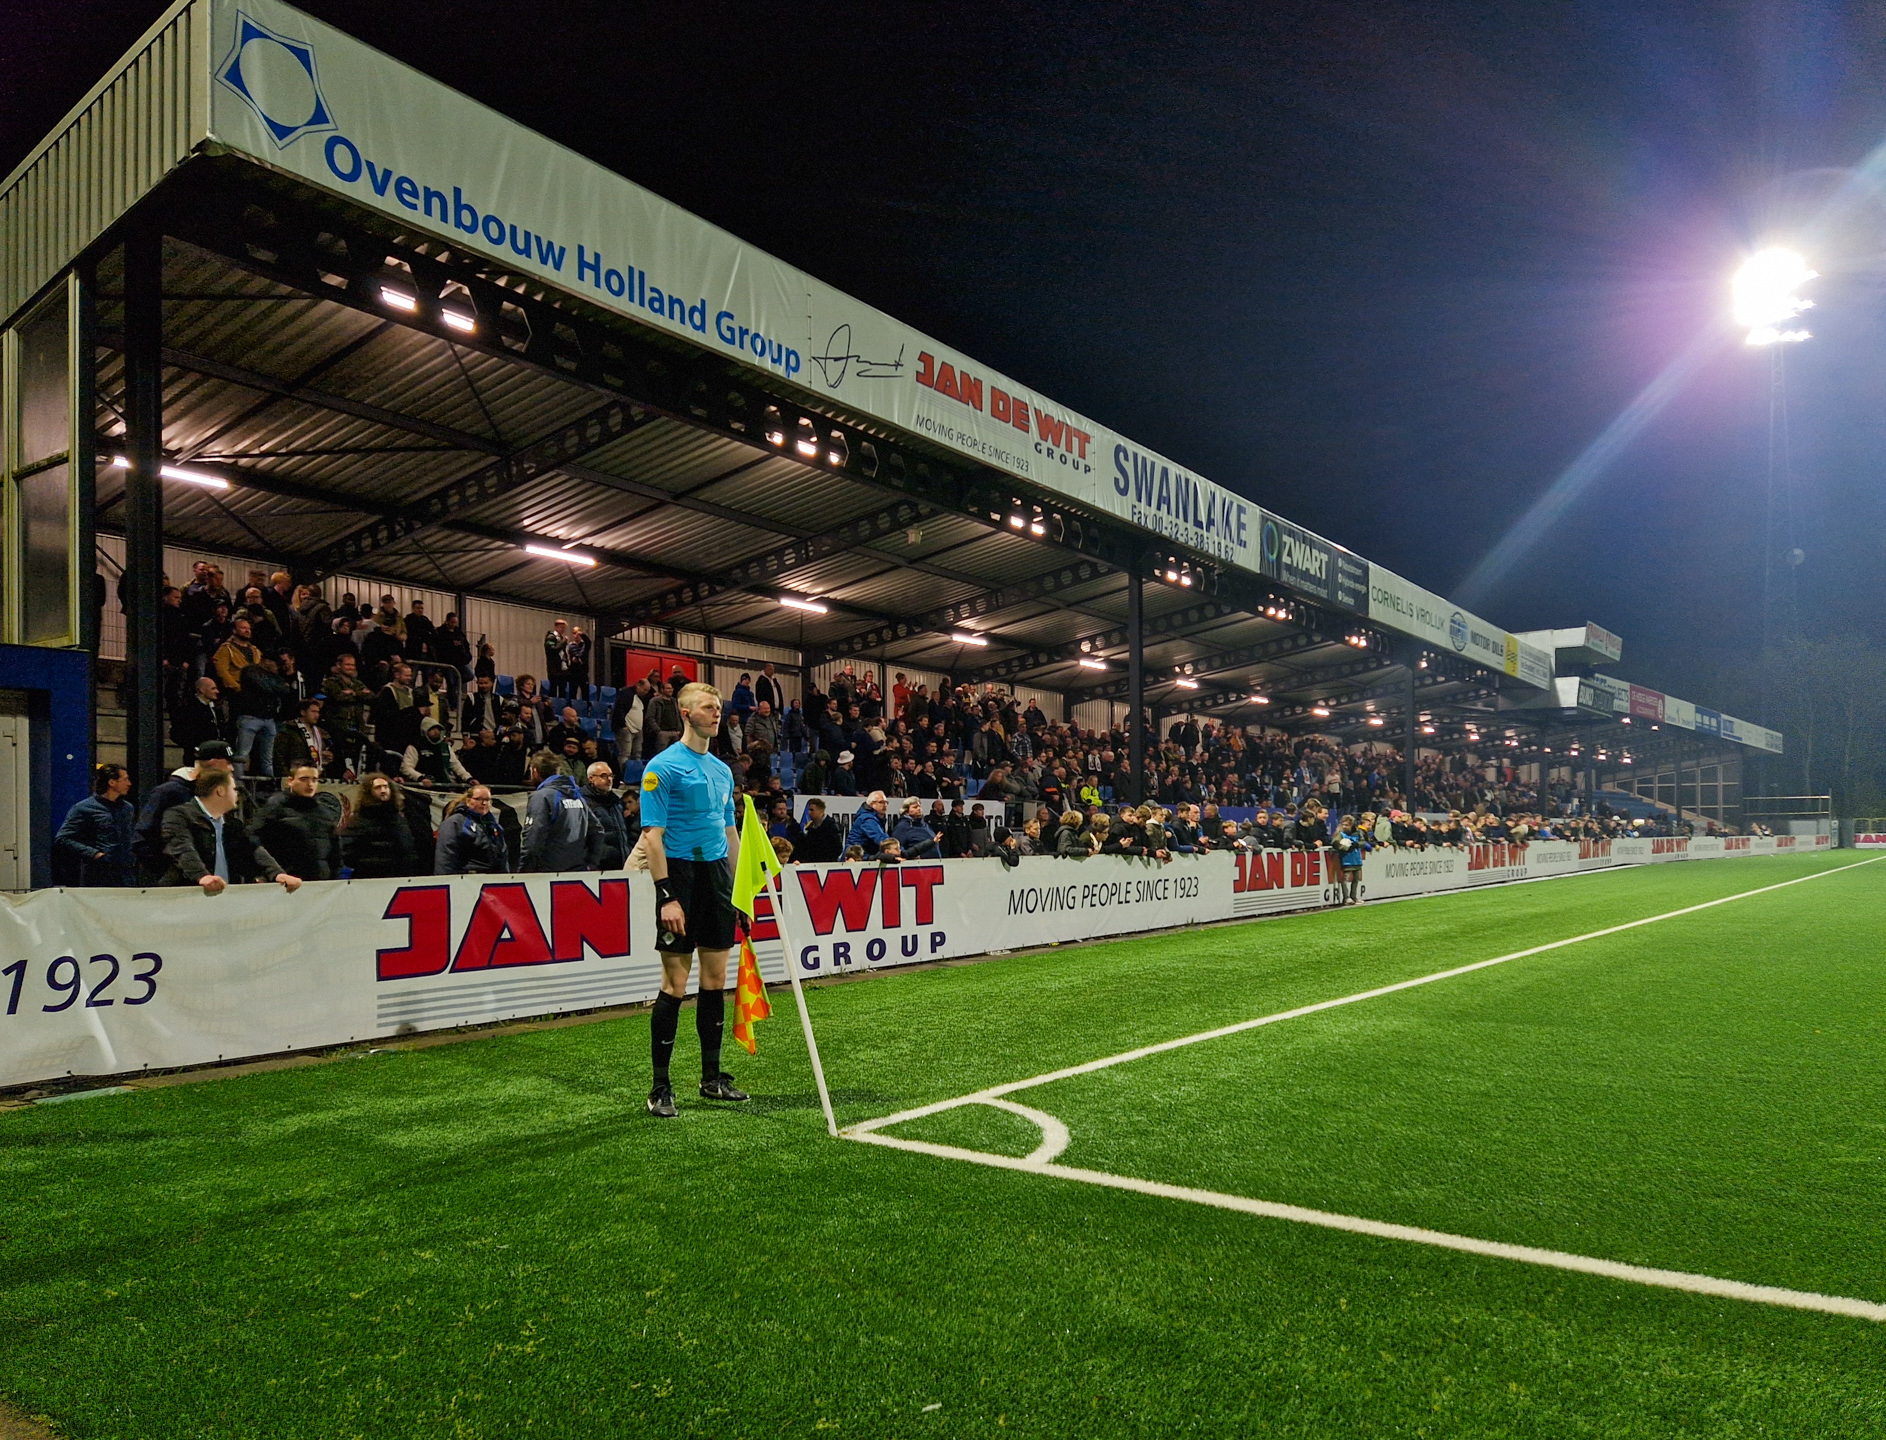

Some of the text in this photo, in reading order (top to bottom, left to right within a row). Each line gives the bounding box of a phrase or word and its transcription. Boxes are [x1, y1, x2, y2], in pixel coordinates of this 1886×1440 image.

[324, 134, 566, 272] Ovenbouw
[577, 244, 706, 334] Holland
[715, 310, 800, 378] Group
[915, 350, 983, 412] JAN
[990, 386, 1030, 434] DE
[1034, 407, 1091, 460] WIT
[915, 414, 1030, 472] MOVING PEOPLE SINCE 1923
[1034, 442, 1092, 475] GROUP
[1113, 443, 1248, 549] SWANLAKE
[1131, 504, 1149, 529] Fax
[1281, 534, 1329, 580] ZWART
[1371, 585, 1414, 618] CORNELIS
[1415, 605, 1446, 632] VROLIJK
[1470, 630, 1491, 651] MOTOR
[1233, 851, 1284, 893] JAN
[1290, 850, 1321, 887] DE
[1385, 862, 1410, 879] MOVING
[1410, 861, 1429, 877] PEOPLE
[1429, 860, 1443, 875] SINCE
[1467, 842, 1530, 871] JAN DE WIT
[1008, 876, 1200, 916] MOVING PEOPLE SINCE 1923
[1323, 884, 1366, 902] GRP
[376, 878, 631, 982] JAN
[795, 865, 945, 937] WIT
[800, 931, 947, 971] GROUP
[1, 951, 164, 1016] 1923
